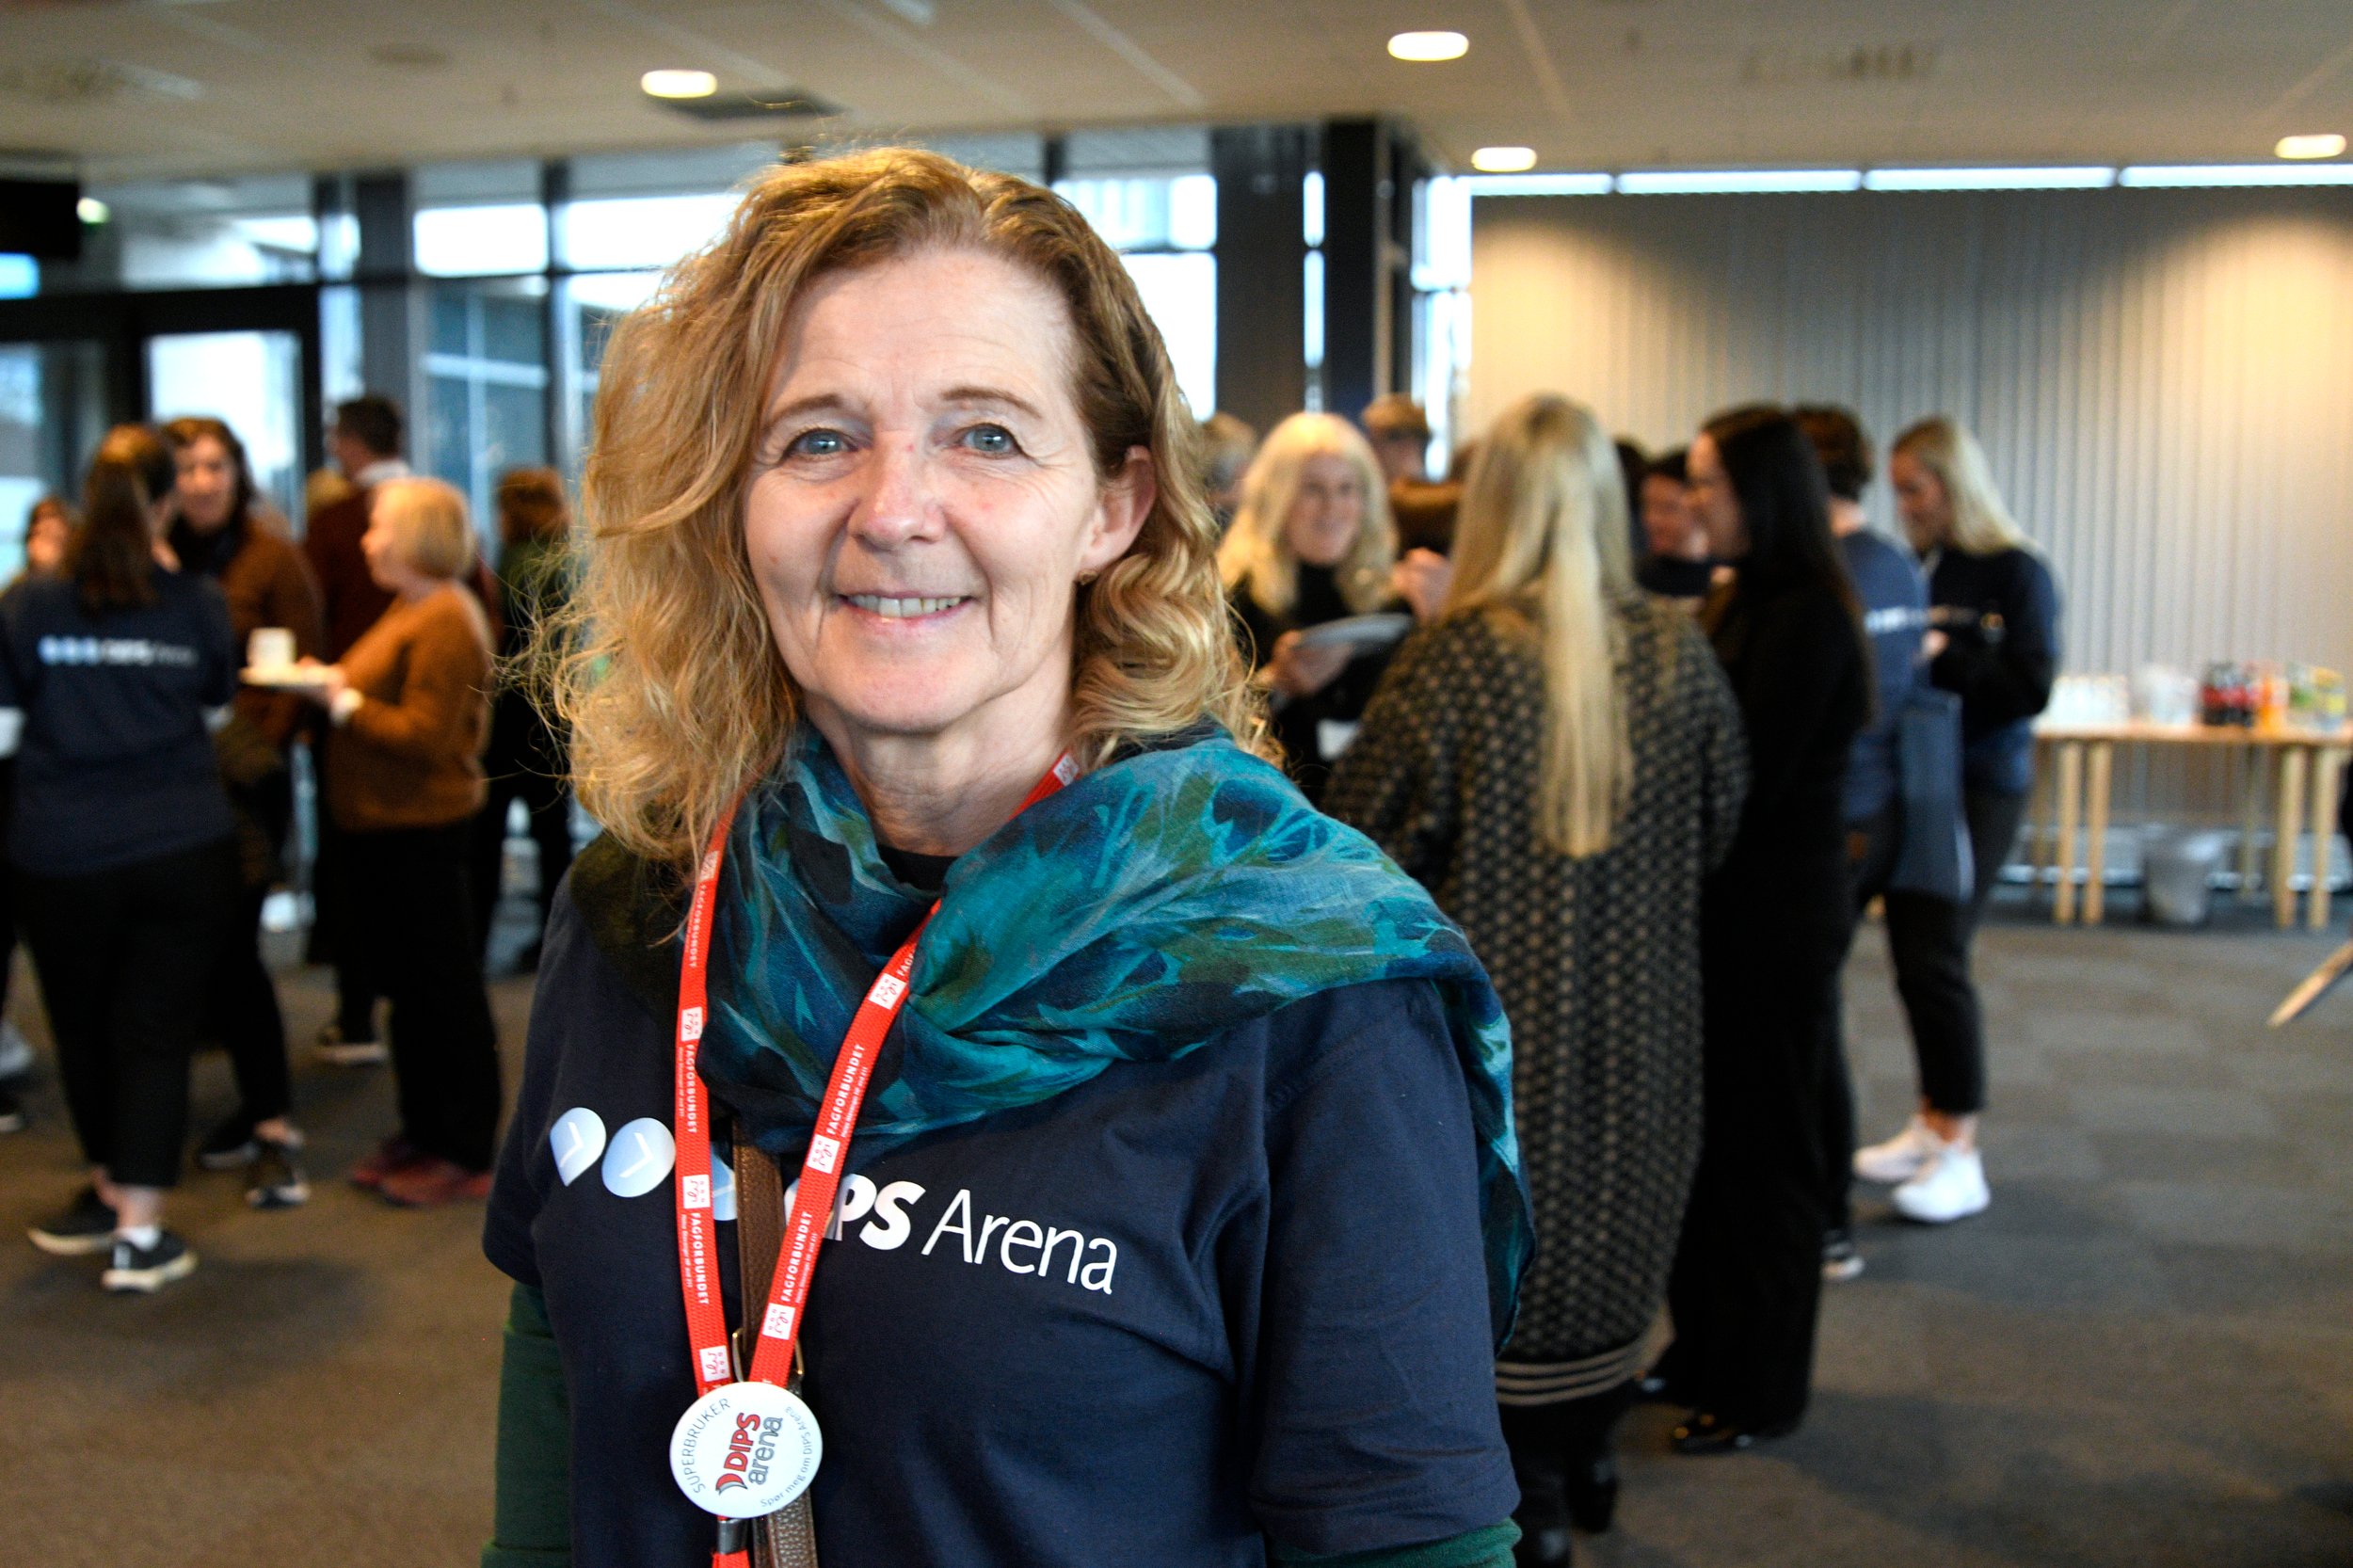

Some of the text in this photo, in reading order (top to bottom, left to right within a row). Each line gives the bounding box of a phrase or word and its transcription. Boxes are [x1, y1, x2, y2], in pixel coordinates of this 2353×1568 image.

[686, 1044, 697, 1133] FAGFORBUNDET
[825, 1044, 865, 1135] FAGFORBUNDET
[691, 1212, 709, 1304] FAGFORBUNDET
[780, 1211, 812, 1303] FAGFORBUNDET
[784, 1174, 1117, 1294] PS Arena
[681, 1398, 730, 1494] SUPERBRUKER
[723, 1412, 761, 1472] DIPS
[748, 1416, 783, 1485] arena
[784, 1406, 808, 1431] Arena
[801, 1432, 812, 1455] DIPS
[785, 1474, 807, 1494] meg
[800, 1457, 811, 1473] om
